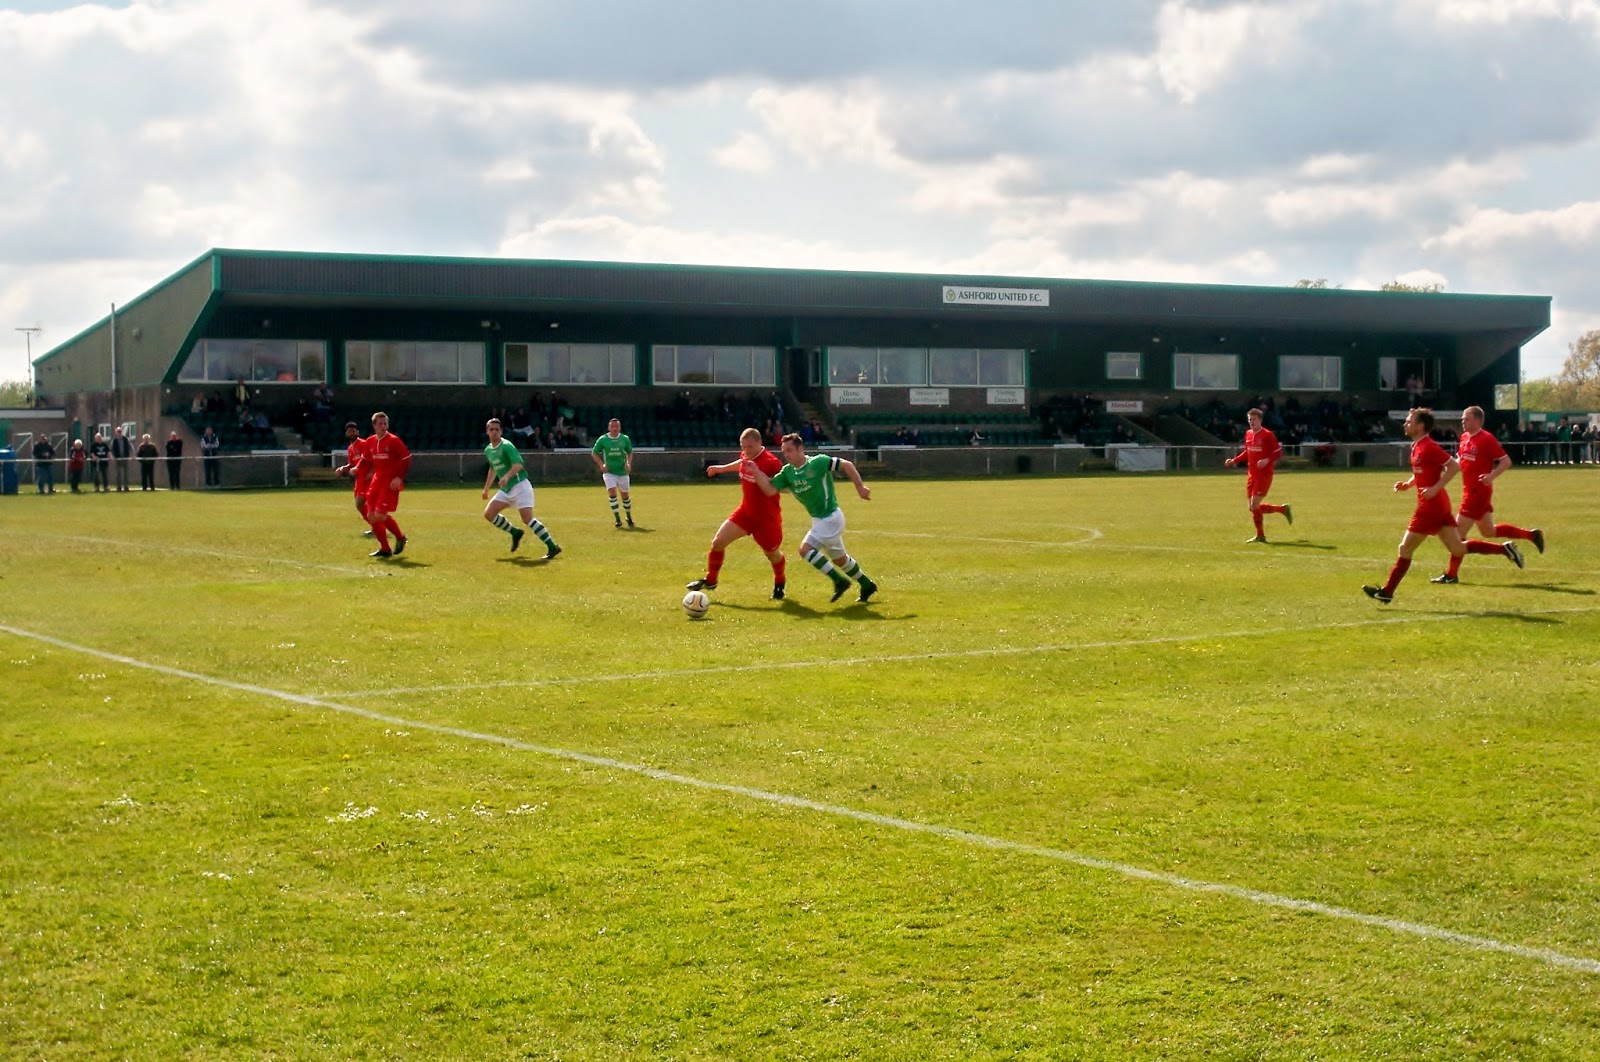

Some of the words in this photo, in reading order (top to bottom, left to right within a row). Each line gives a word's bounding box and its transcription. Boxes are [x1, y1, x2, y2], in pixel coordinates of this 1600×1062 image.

[958, 290, 996, 300] ASHFORD
[998, 292, 1027, 301] UNITED
[1029, 293, 1042, 302] F.C.
